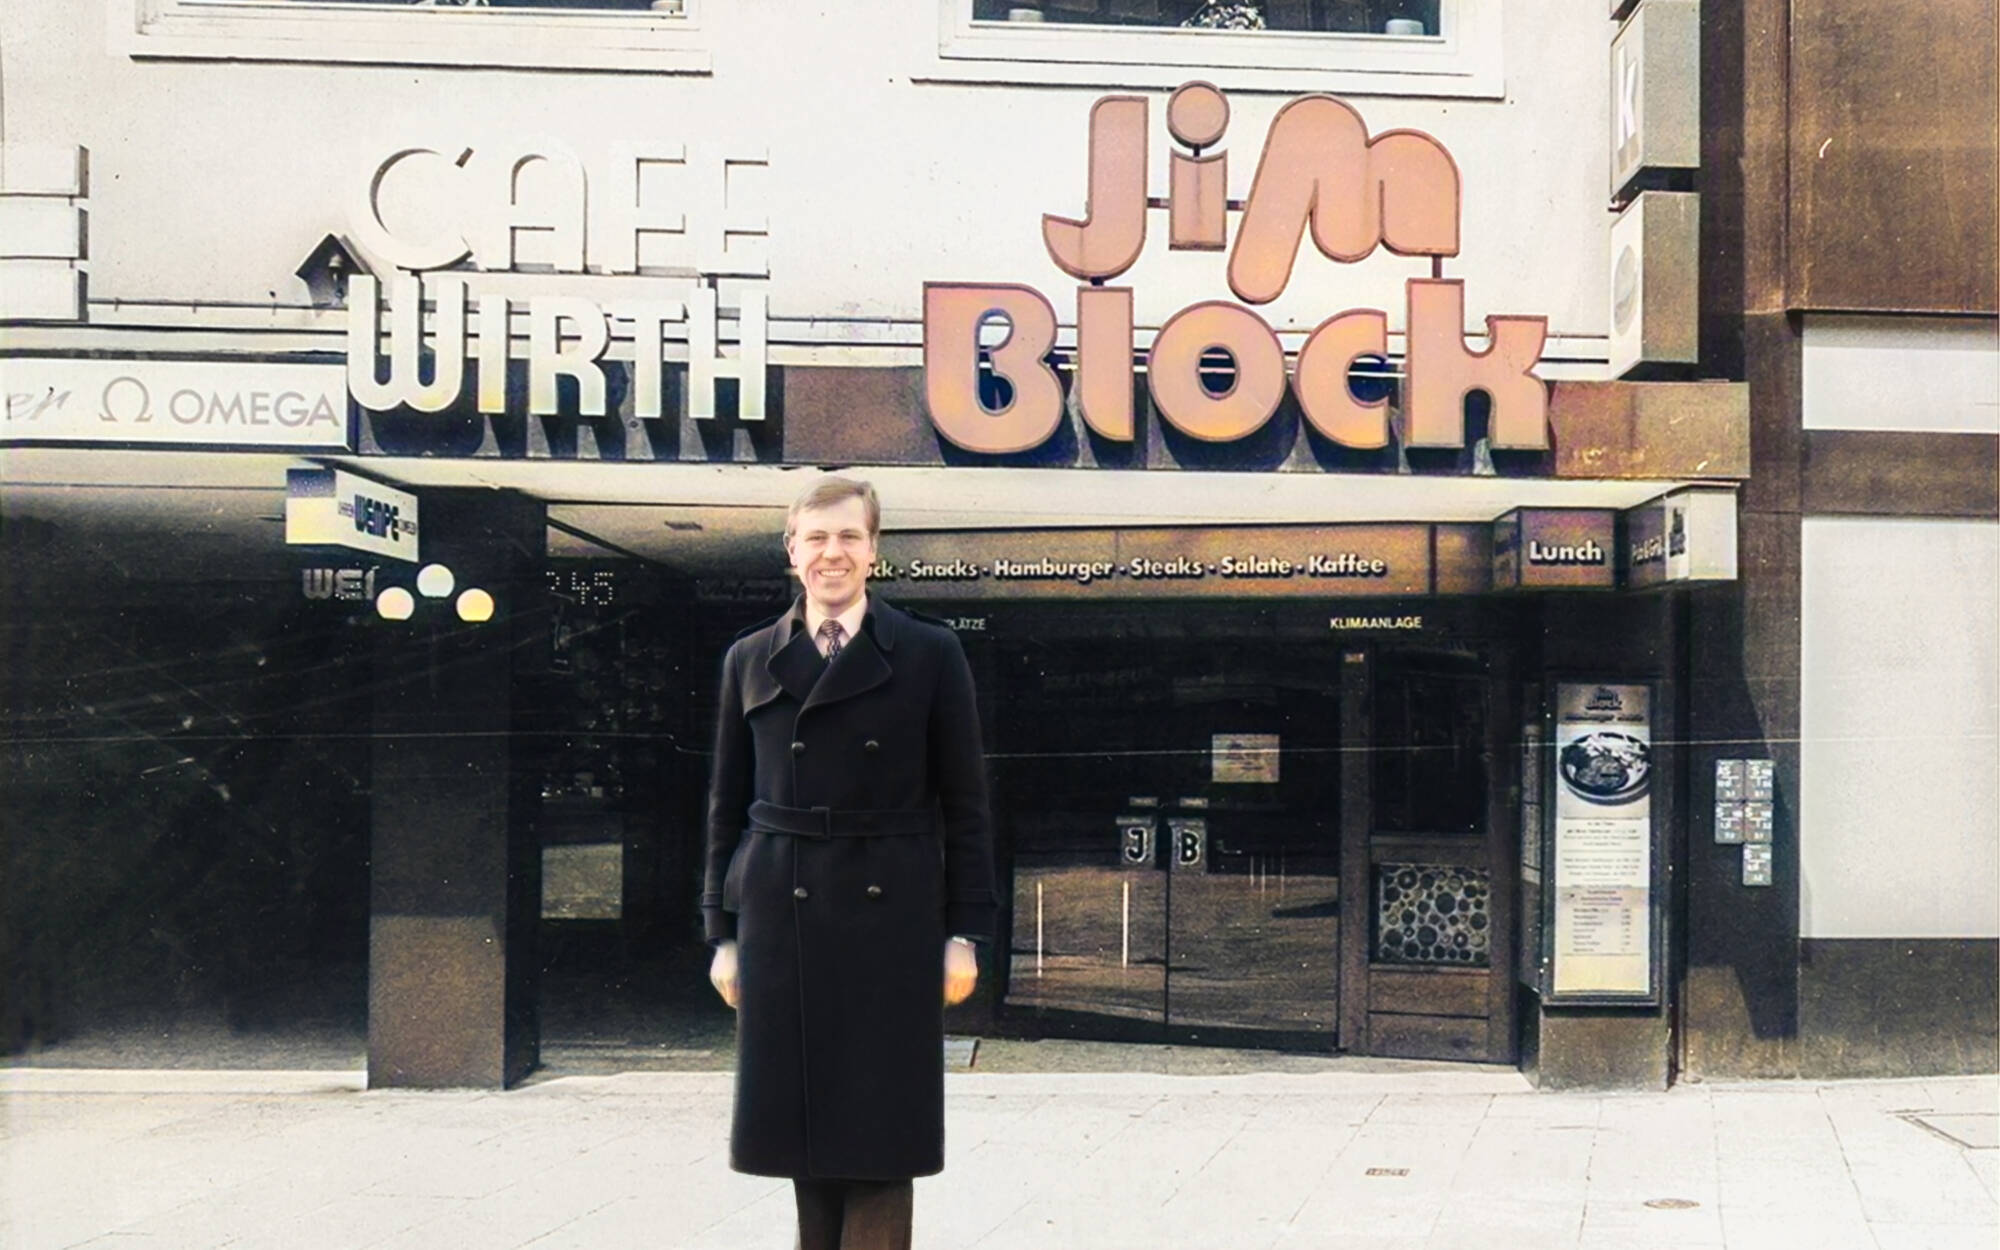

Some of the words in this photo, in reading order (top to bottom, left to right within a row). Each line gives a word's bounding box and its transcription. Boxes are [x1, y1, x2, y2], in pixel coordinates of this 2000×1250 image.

[347, 138, 769, 279] CAFE
[1042, 80, 1460, 304] Jim
[347, 274, 769, 420] WIRTH
[923, 278, 1548, 454] Block
[169, 388, 341, 427] OMEGA
[910, 559, 978, 578] Snacks
[994, 557, 1114, 582] Hamburger
[1130, 556, 1203, 576] Steaks
[1221, 555, 1292, 575] Salate
[1308, 553, 1385, 574] Kaffee
[1530, 539, 1602, 562] Lunch
[1329, 616, 1423, 630] KLIMAANLAGE
[1125, 827, 1148, 863] J
[1178, 829, 1201, 866] B
